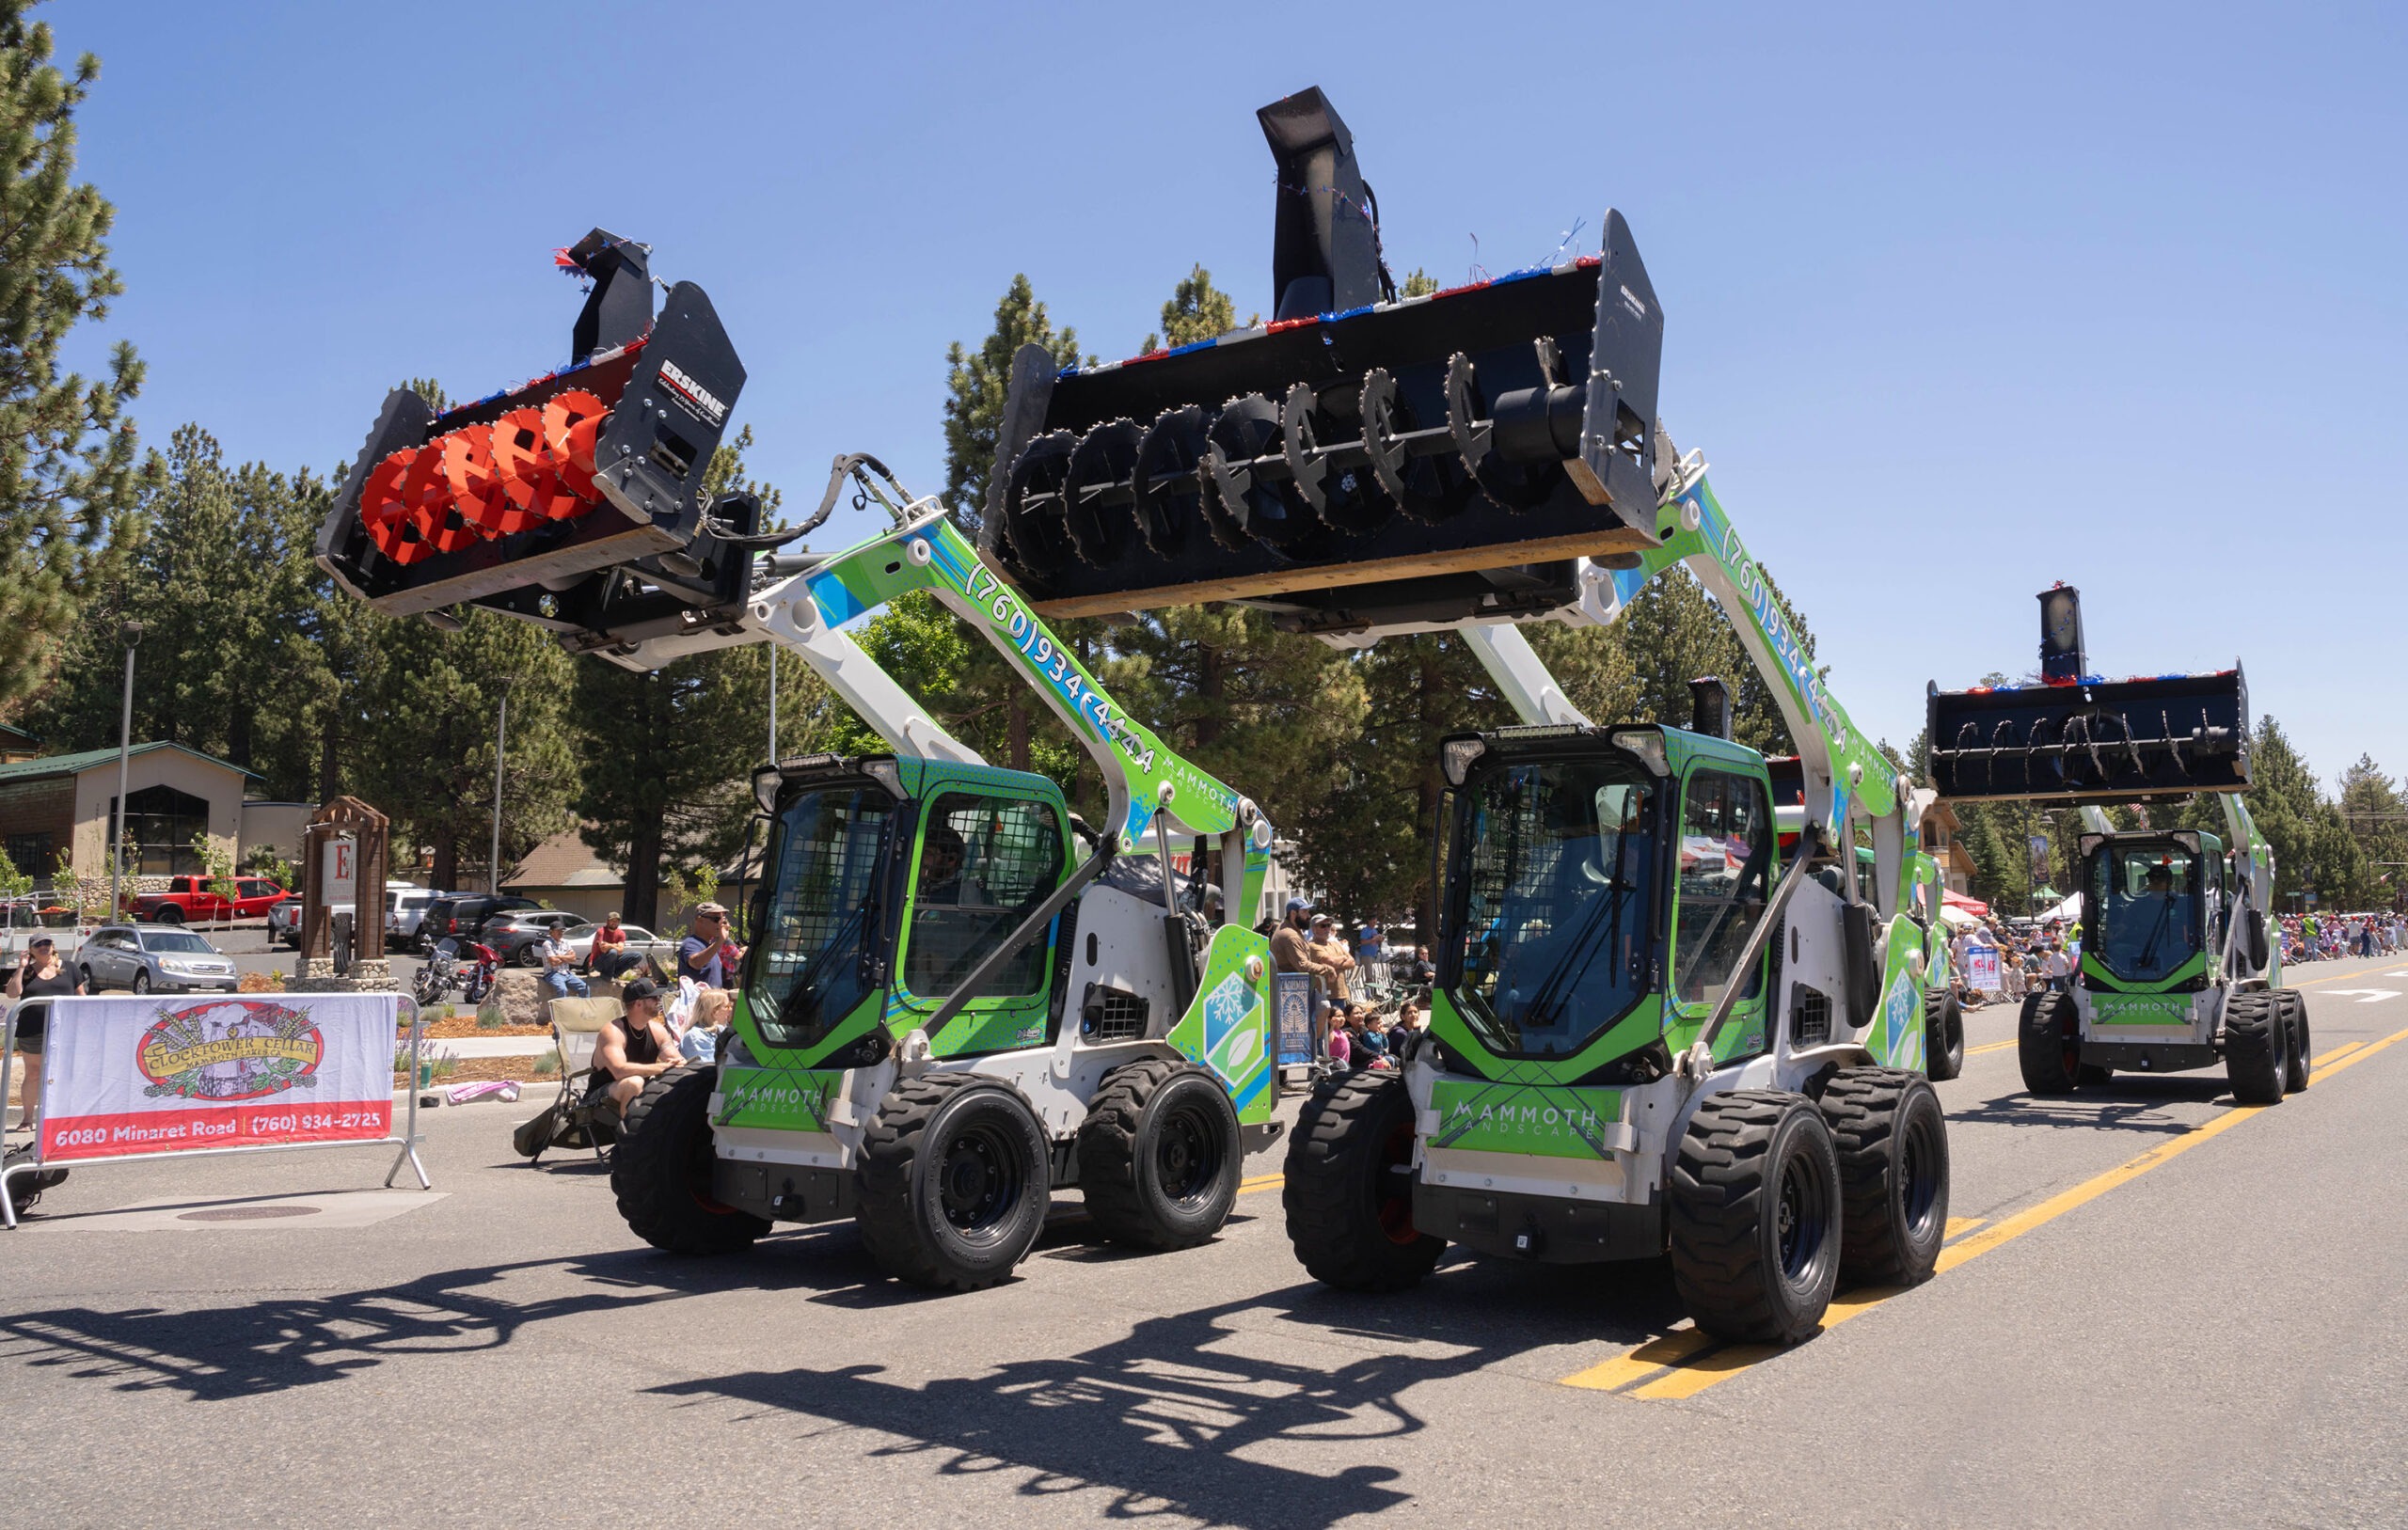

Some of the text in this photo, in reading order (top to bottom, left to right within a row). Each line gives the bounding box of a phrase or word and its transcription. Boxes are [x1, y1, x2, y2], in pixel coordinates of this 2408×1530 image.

[660, 359, 727, 418] ERSKINE
[1162, 755, 1236, 814] MAMMOTH
[2103, 1002, 2181, 1011] MAMMOTH
[149, 1038, 315, 1070] CLOCKTOWER CELLAR
[187, 1052, 238, 1069] MAMMOTH
[732, 1084, 823, 1105] MAMMOTH
[1451, 1100, 1596, 1128] MAMMOTH
[55, 1112, 381, 1146] 6080 Minaret Road (760) 934-2725
[1450, 1120, 1594, 1140] LANDSCAPE
